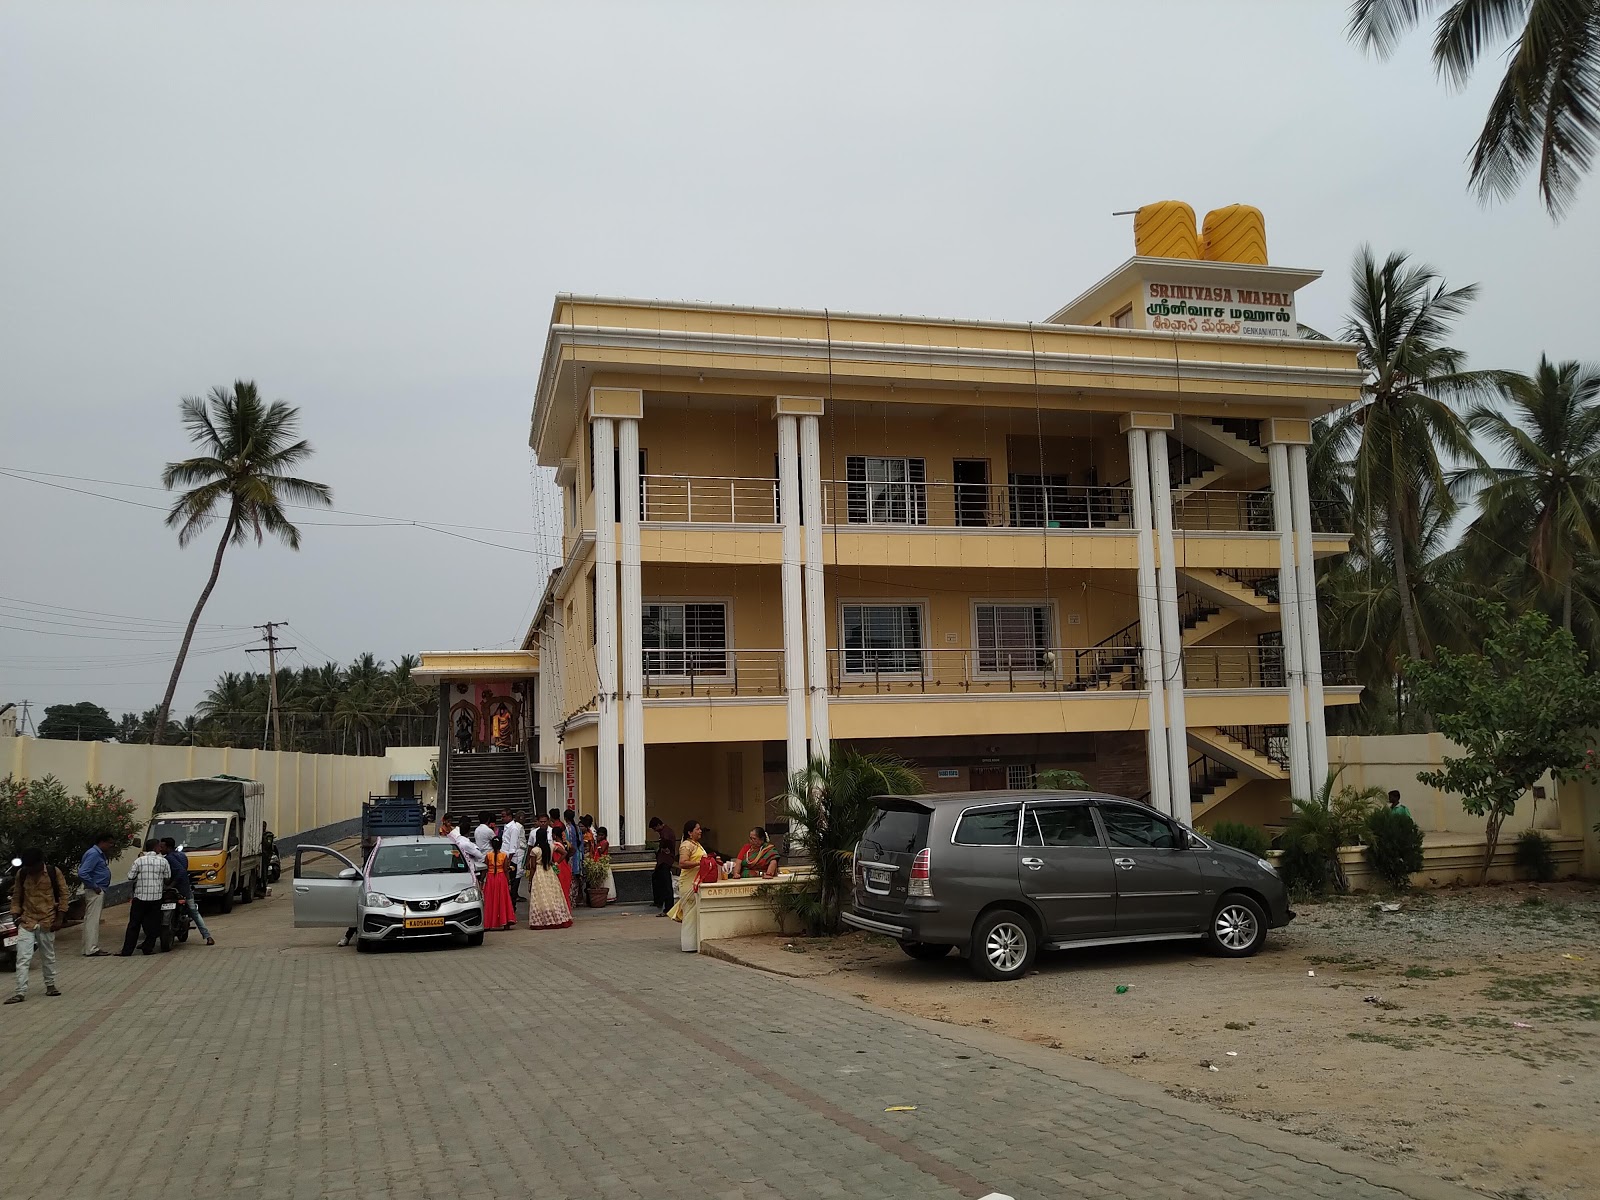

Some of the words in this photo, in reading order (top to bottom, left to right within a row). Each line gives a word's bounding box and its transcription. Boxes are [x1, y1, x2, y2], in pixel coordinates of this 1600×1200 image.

[1149, 283, 1233, 303] SRINIVASA
[1237, 289, 1292, 307] MAHAL
[566, 753, 575, 811] RECEPTION
[724, 887, 754, 896] PARKING
